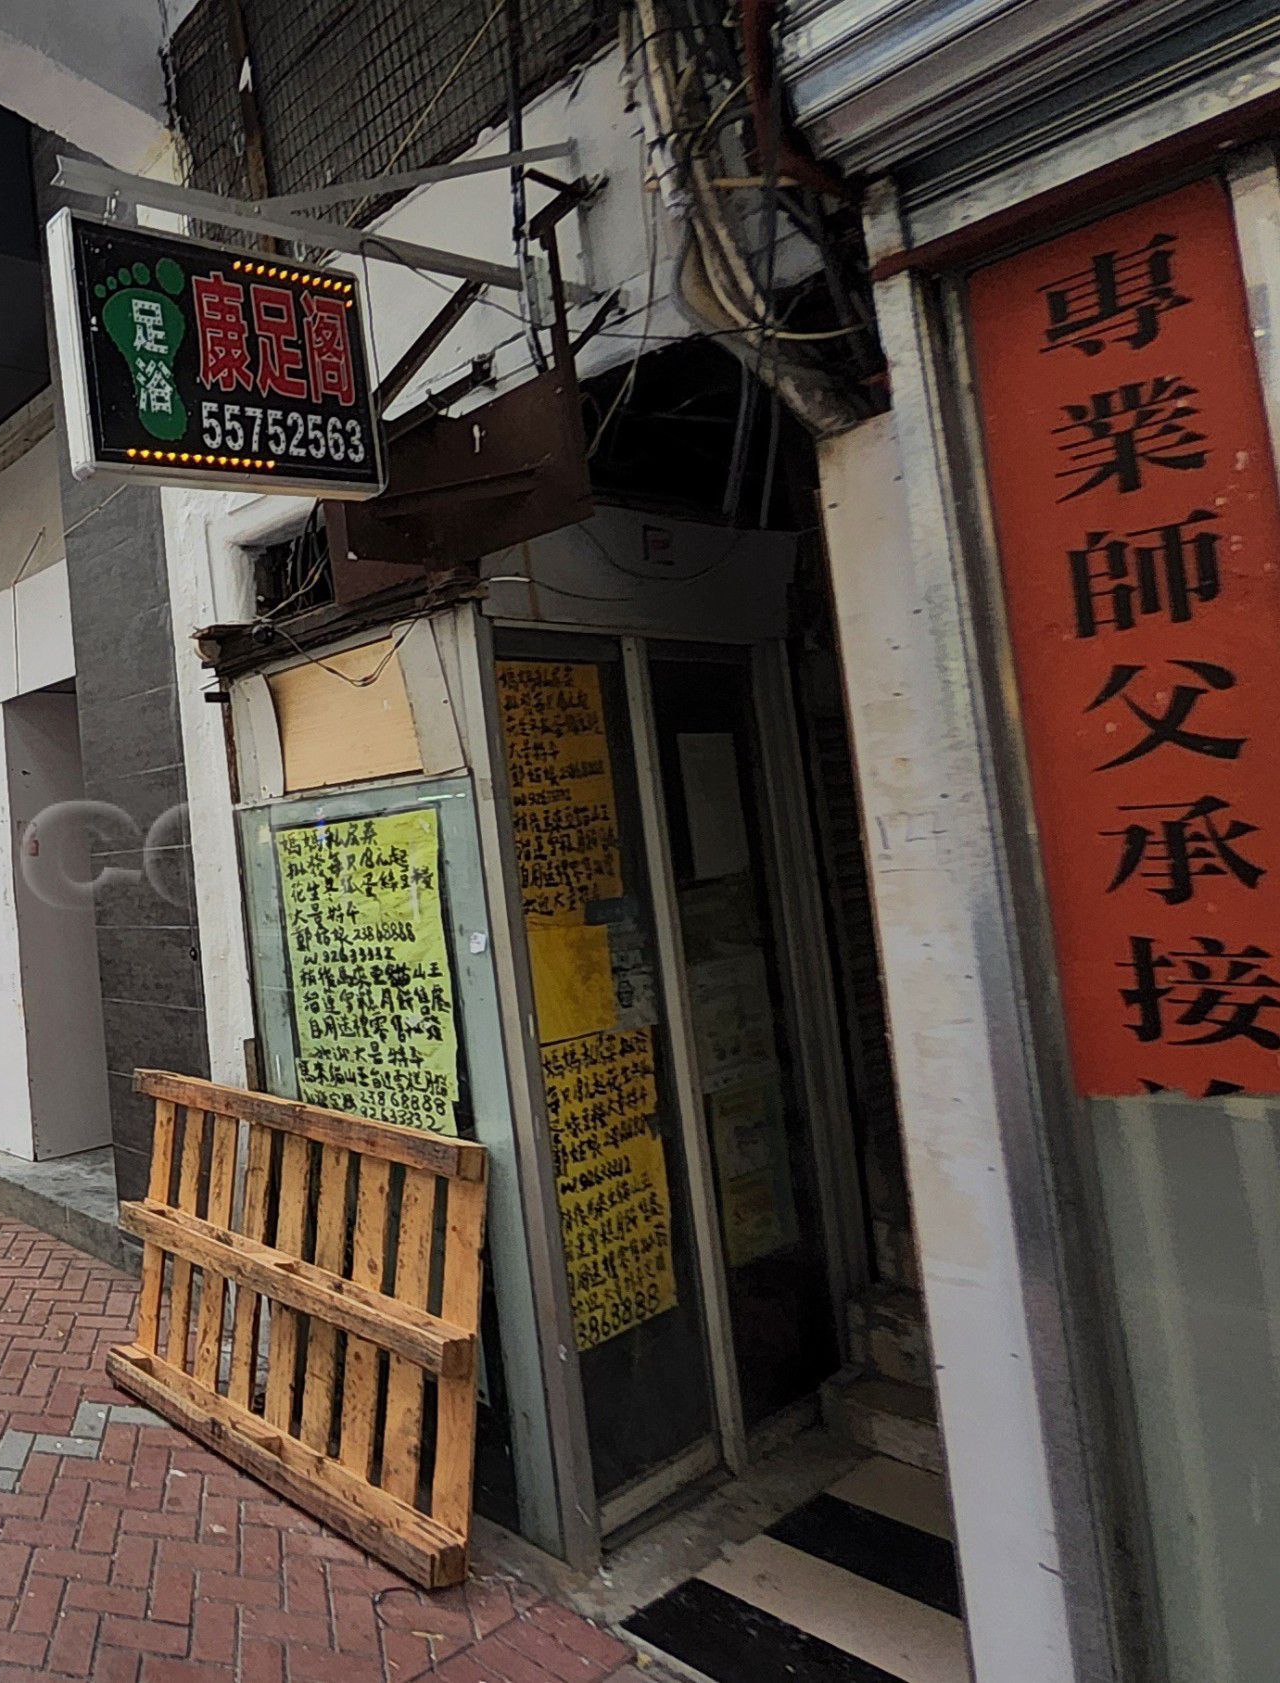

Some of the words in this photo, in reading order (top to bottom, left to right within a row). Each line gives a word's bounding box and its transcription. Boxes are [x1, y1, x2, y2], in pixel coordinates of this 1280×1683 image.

[131, 298, 173, 414] 足浴
[201, 401, 365, 462] 55752563
[1038, 232, 1280, 1097] 專業師父承接
